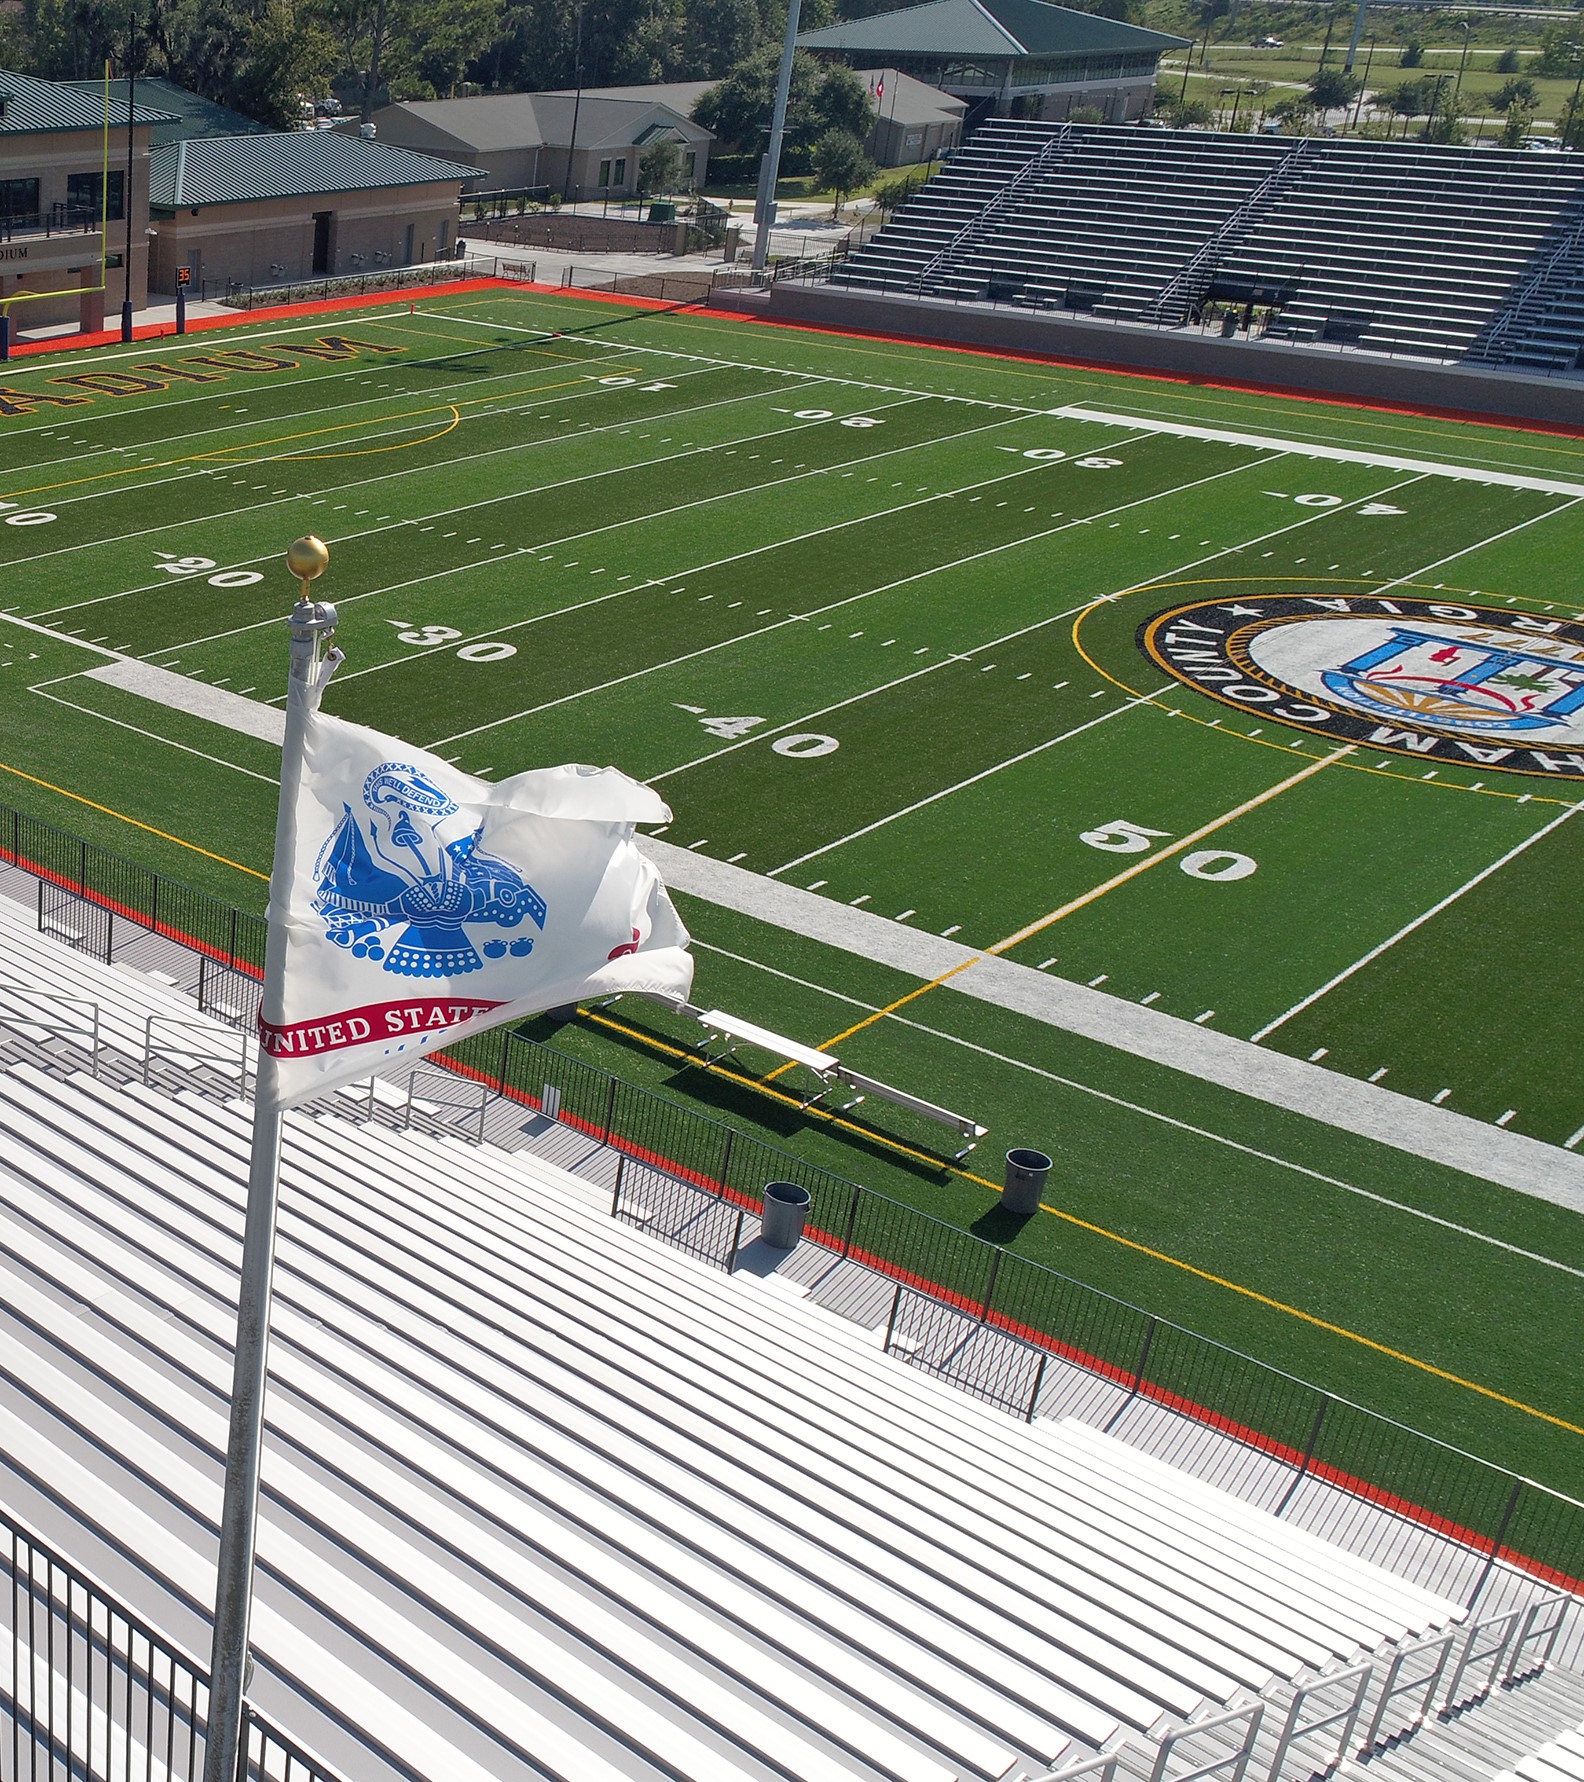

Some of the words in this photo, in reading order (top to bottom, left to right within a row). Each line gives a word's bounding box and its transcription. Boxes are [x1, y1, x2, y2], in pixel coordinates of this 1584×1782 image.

[178, 268, 190, 282] 35
[793, 409, 886, 428] 20
[1022, 448, 1125, 469] 30
[1294, 493, 1409, 516] 40
[154, 556, 264, 588] 20
[396, 624, 517, 663] 30
[1164, 618, 1333, 722] COUNTY
[1333, 685, 1510, 729] CONSTITUTION
[698, 715, 840, 758] 40
[401, 785, 441, 807] DEFEND
[1079, 819, 1259, 882] 50
[260, 1017, 371, 1053] UNITED
